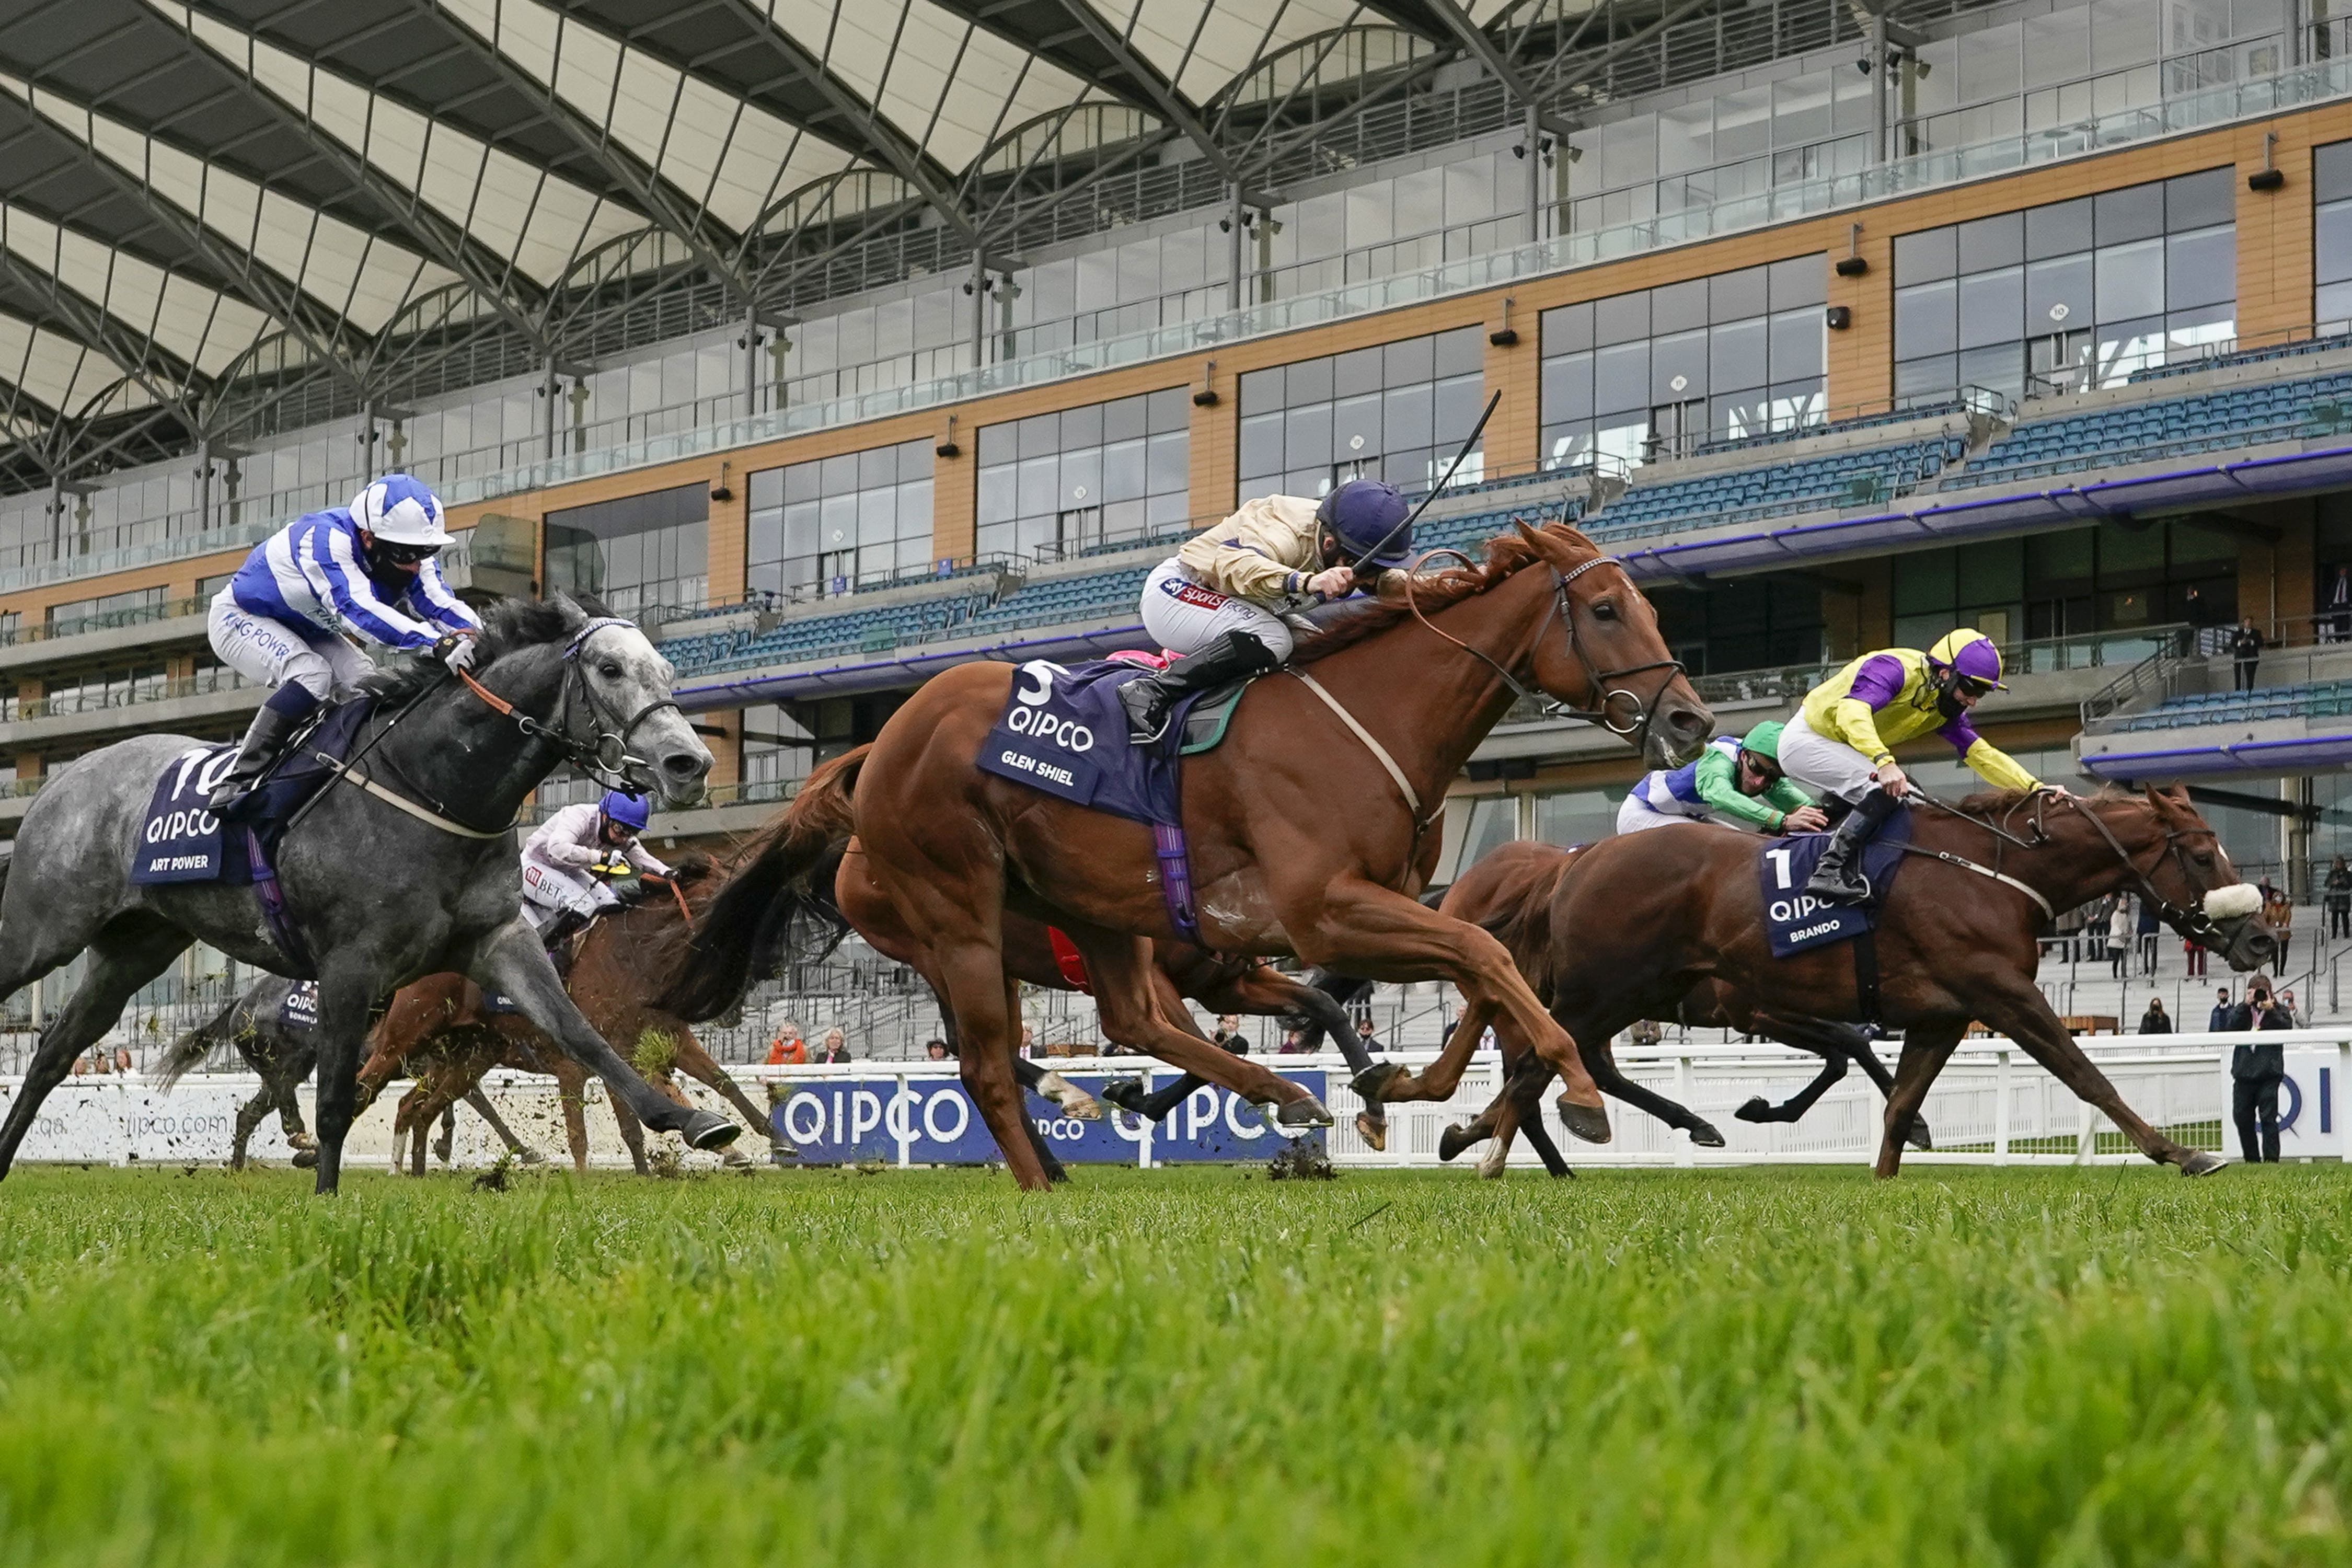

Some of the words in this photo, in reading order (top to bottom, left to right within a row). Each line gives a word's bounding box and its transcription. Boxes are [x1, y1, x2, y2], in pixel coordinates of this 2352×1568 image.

[1183, 587, 1224, 606] sports
[1223, 600, 1258, 621] racing
[222, 612, 253, 637] KING
[251, 629, 290, 661] POWER
[1008, 706, 1094, 752] QIPCO
[1001, 750, 1036, 772] GLEN
[1035, 762, 1074, 787] SHIEL
[146, 808, 220, 844] QIPCO
[149, 857, 170, 872] ART
[171, 855, 209, 871] POWER
[1766, 848, 1792, 889] 1
[539, 878, 562, 898] BET
[1790, 919, 1840, 943] BRANDO
[784, 1089, 969, 1146] QIPCO
